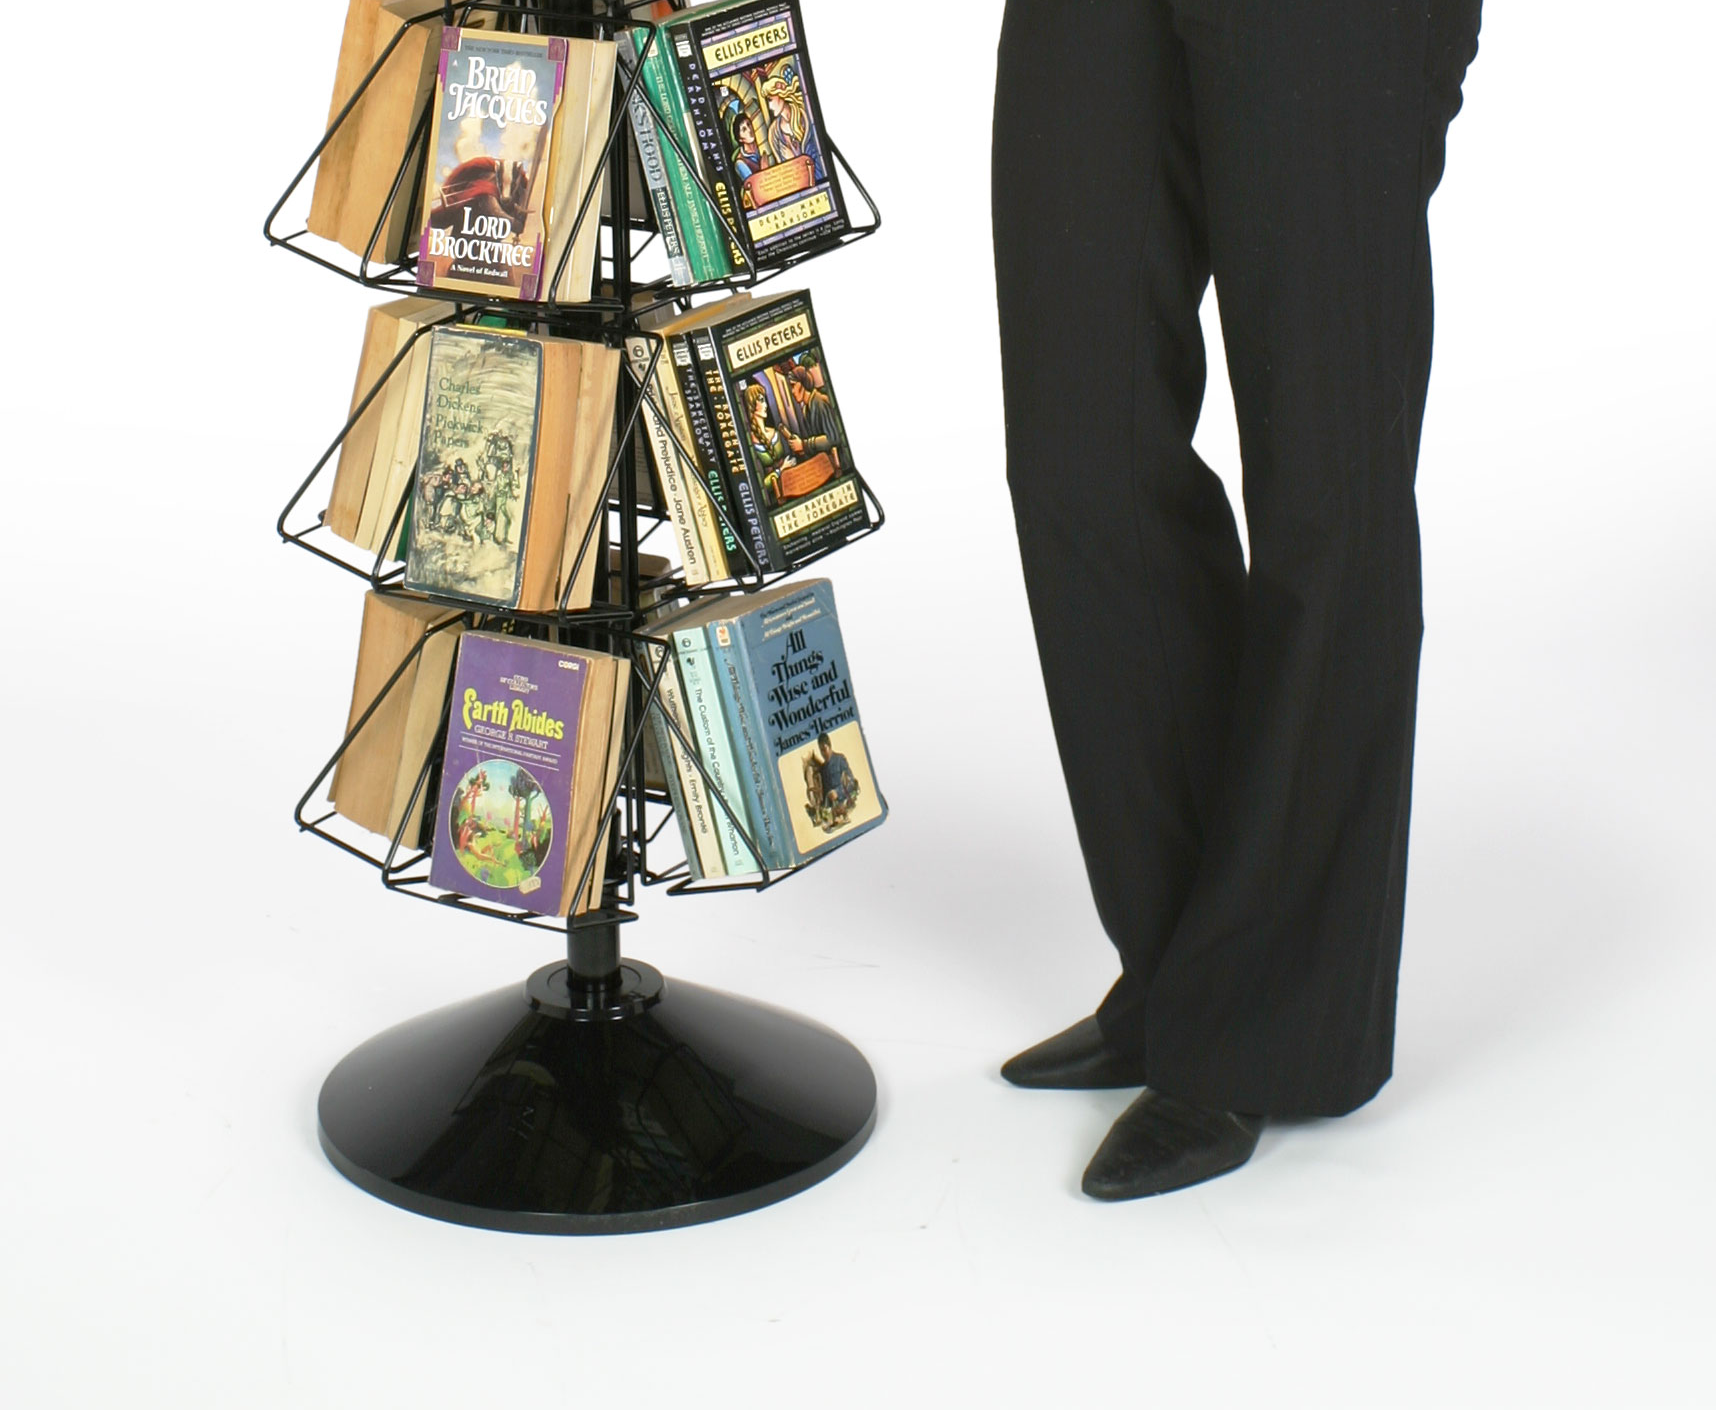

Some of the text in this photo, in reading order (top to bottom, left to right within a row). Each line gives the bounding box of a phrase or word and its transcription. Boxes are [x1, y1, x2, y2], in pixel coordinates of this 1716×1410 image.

[714, 41, 745, 62] ELLIS
[745, 26, 788, 52] PETERS
[467, 56, 536, 96] BRIAN
[448, 83, 548, 128] JACQUES
[687, 85, 709, 151] RANSOM
[688, 61, 723, 173] DEAD MAN'S
[639, 129, 663, 182] HOOD
[714, 180, 732, 215] ELLIS
[461, 207, 511, 239] LORD
[656, 189, 680, 255] ELLIS PETERS
[757, 210, 786, 226] DEAD
[774, 208, 816, 229] RANSOM
[429, 228, 534, 267] BROCKTREE
[457, 265, 475, 273] Novel
[483, 268, 508, 277] Redwall
[736, 342, 763, 361] ELLIS
[764, 322, 804, 349] PETERS
[438, 395, 481, 414] Dickens
[439, 377, 481, 395] Charles
[435, 414, 483, 434] Pickwick
[684, 388, 704, 446] SPARROW
[685, 367, 715, 464] THE SANCTUARY
[704, 369, 717, 393] THE
[713, 403, 738, 475] FOREGATE
[712, 368, 746, 472] THE RAVEN IN
[433, 430, 468, 449] Papers
[656, 438, 679, 493] Prejudice
[672, 496, 687, 525] Jane
[680, 526, 697, 565] Austen
[706, 469, 723, 502] ELLIS
[778, 483, 852, 523] THE RAVEN IN
[737, 481, 768, 566] ELLIS PETERS
[781, 519, 799, 533] THE
[804, 492, 857, 521] FOREGATE
[781, 629, 807, 662] All
[557, 659, 580, 670] CORGI
[772, 650, 824, 687] Things
[693, 687, 704, 704] The
[768, 660, 838, 707] Wise and
[462, 688, 564, 740] Earth Abides
[697, 704, 712, 737] Custom
[769, 678, 851, 731] Wonderful
[473, 724, 548, 749] GEORGE STEWART
[705, 736, 715, 747] of
[774, 705, 854, 756] James Herriot
[708, 746, 718, 760] the
[686, 778, 700, 804] Emily
[710, 760, 726, 794] Country
